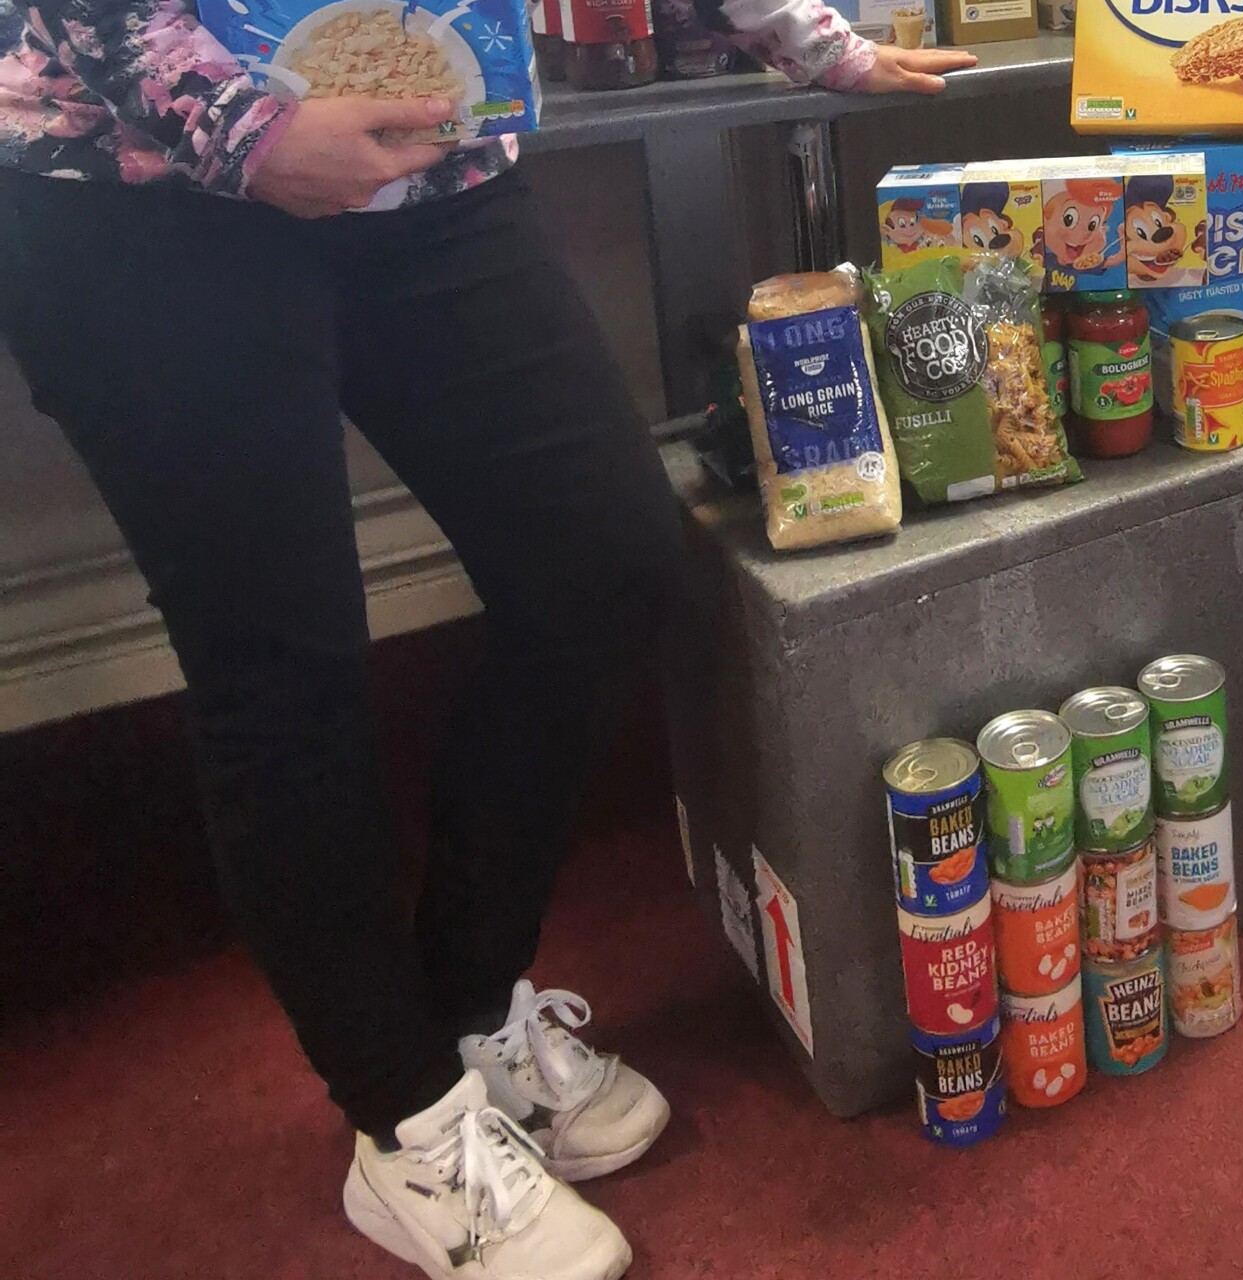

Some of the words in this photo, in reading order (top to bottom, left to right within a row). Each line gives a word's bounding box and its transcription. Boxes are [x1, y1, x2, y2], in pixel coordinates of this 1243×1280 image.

[902, 315, 956, 343] HEARTY
[780, 390, 814, 410] LONG
[816, 381, 856, 399] GRAIN
[807, 401, 835, 418] RICE
[893, 409, 953, 430] FUSILLI
[929, 805, 973, 838] BAKED
[931, 824, 975, 856] BEANS
[1171, 841, 1218, 861] BAKED
[1171, 856, 1219, 878] BEANS
[1035, 921, 1075, 945] BEAN
[927, 945, 988, 978] KIDNEY
[941, 939, 978, 963] RED
[932, 961, 988, 992] BEANS
[1112, 972, 1156, 999] HEINZ
[1107, 987, 1160, 1022] BEANZ
[1028, 1022, 1075, 1047] BAKED
[1029, 1033, 1075, 1058] BEANS
[936, 1052, 981, 1078] BAKED
[938, 1068, 984, 1094] BEANS
